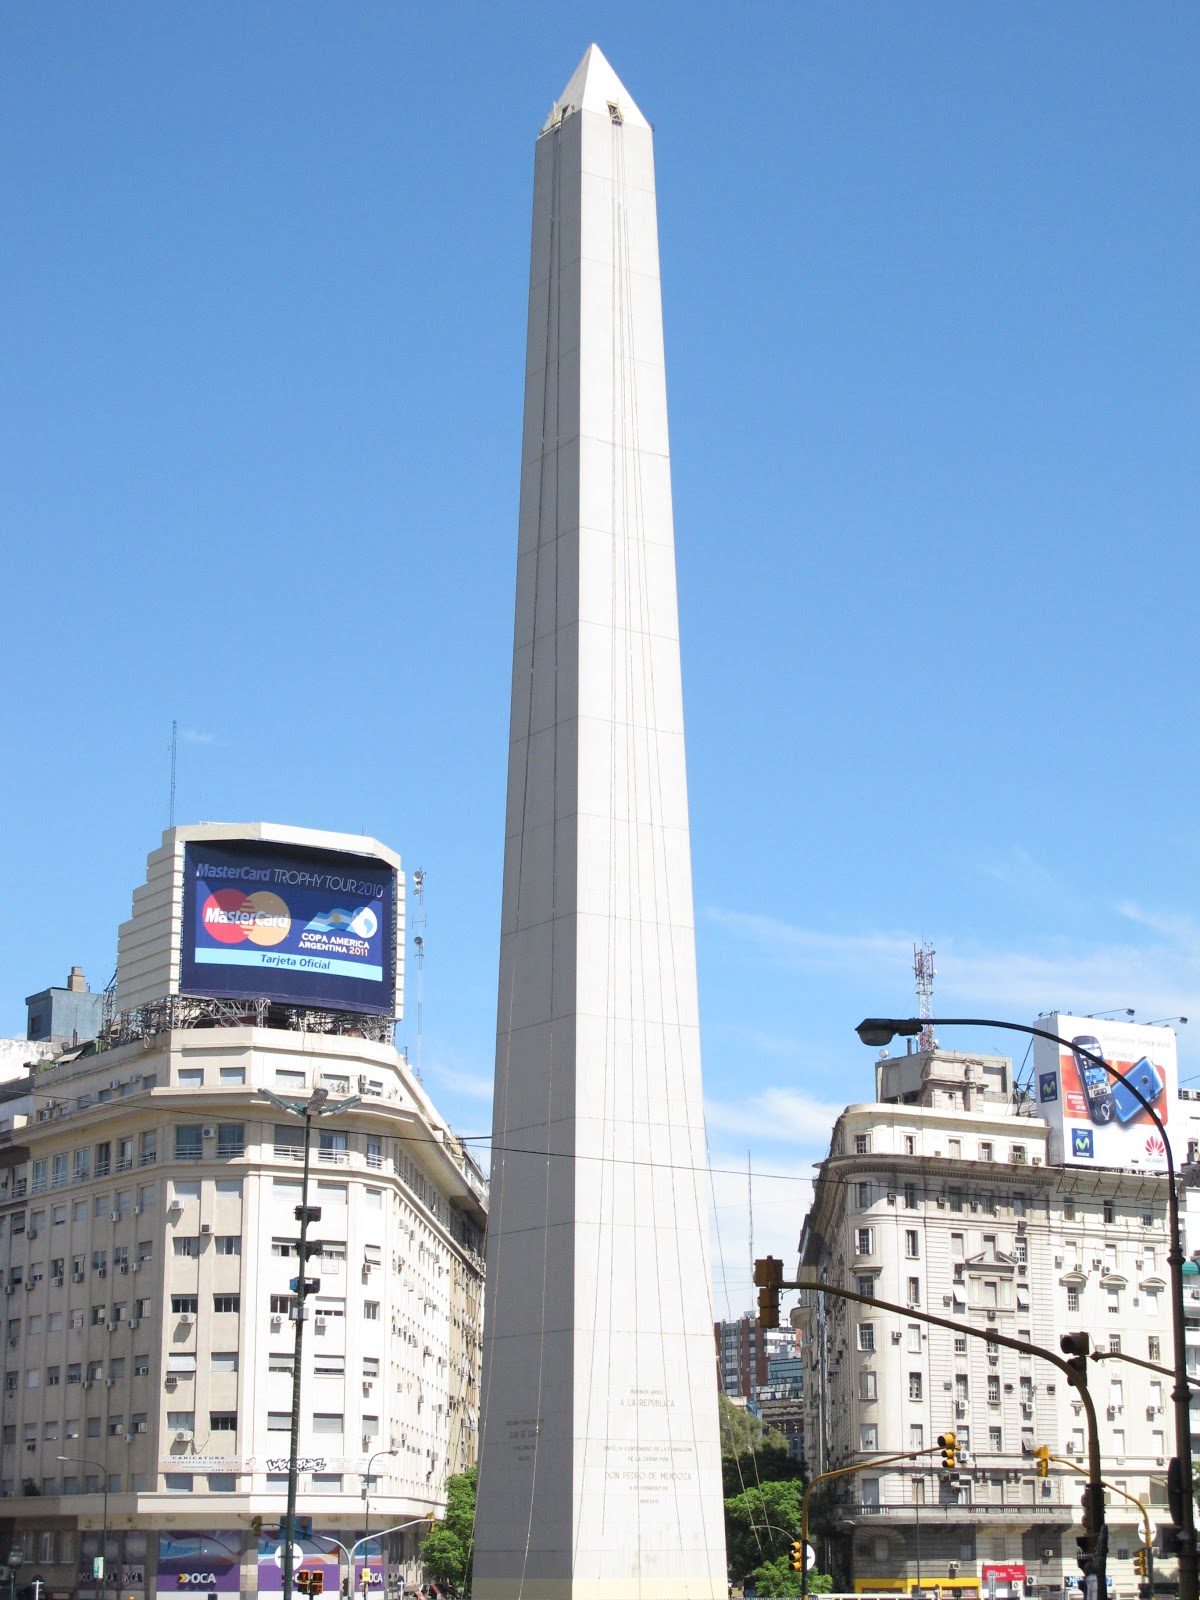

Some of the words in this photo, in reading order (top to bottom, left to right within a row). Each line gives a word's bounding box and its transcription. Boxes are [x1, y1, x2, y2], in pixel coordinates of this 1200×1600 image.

[196, 863, 270, 881] MasterCard
[274, 869, 324, 887] TROPHY
[326, 875, 357, 893] TOUR
[358, 881, 384, 898] 2010
[204, 907, 289, 930] MasterCard
[298, 940, 348, 954] ARGENTINA
[348, 946, 368, 957] 2011
[302, 932, 328, 944] COPA
[330, 936, 370, 950] AMERICA
[260, 954, 296, 967] Tarjeta
[299, 958, 331, 970] Oficial
[191, 1572, 216, 1584] OCA
